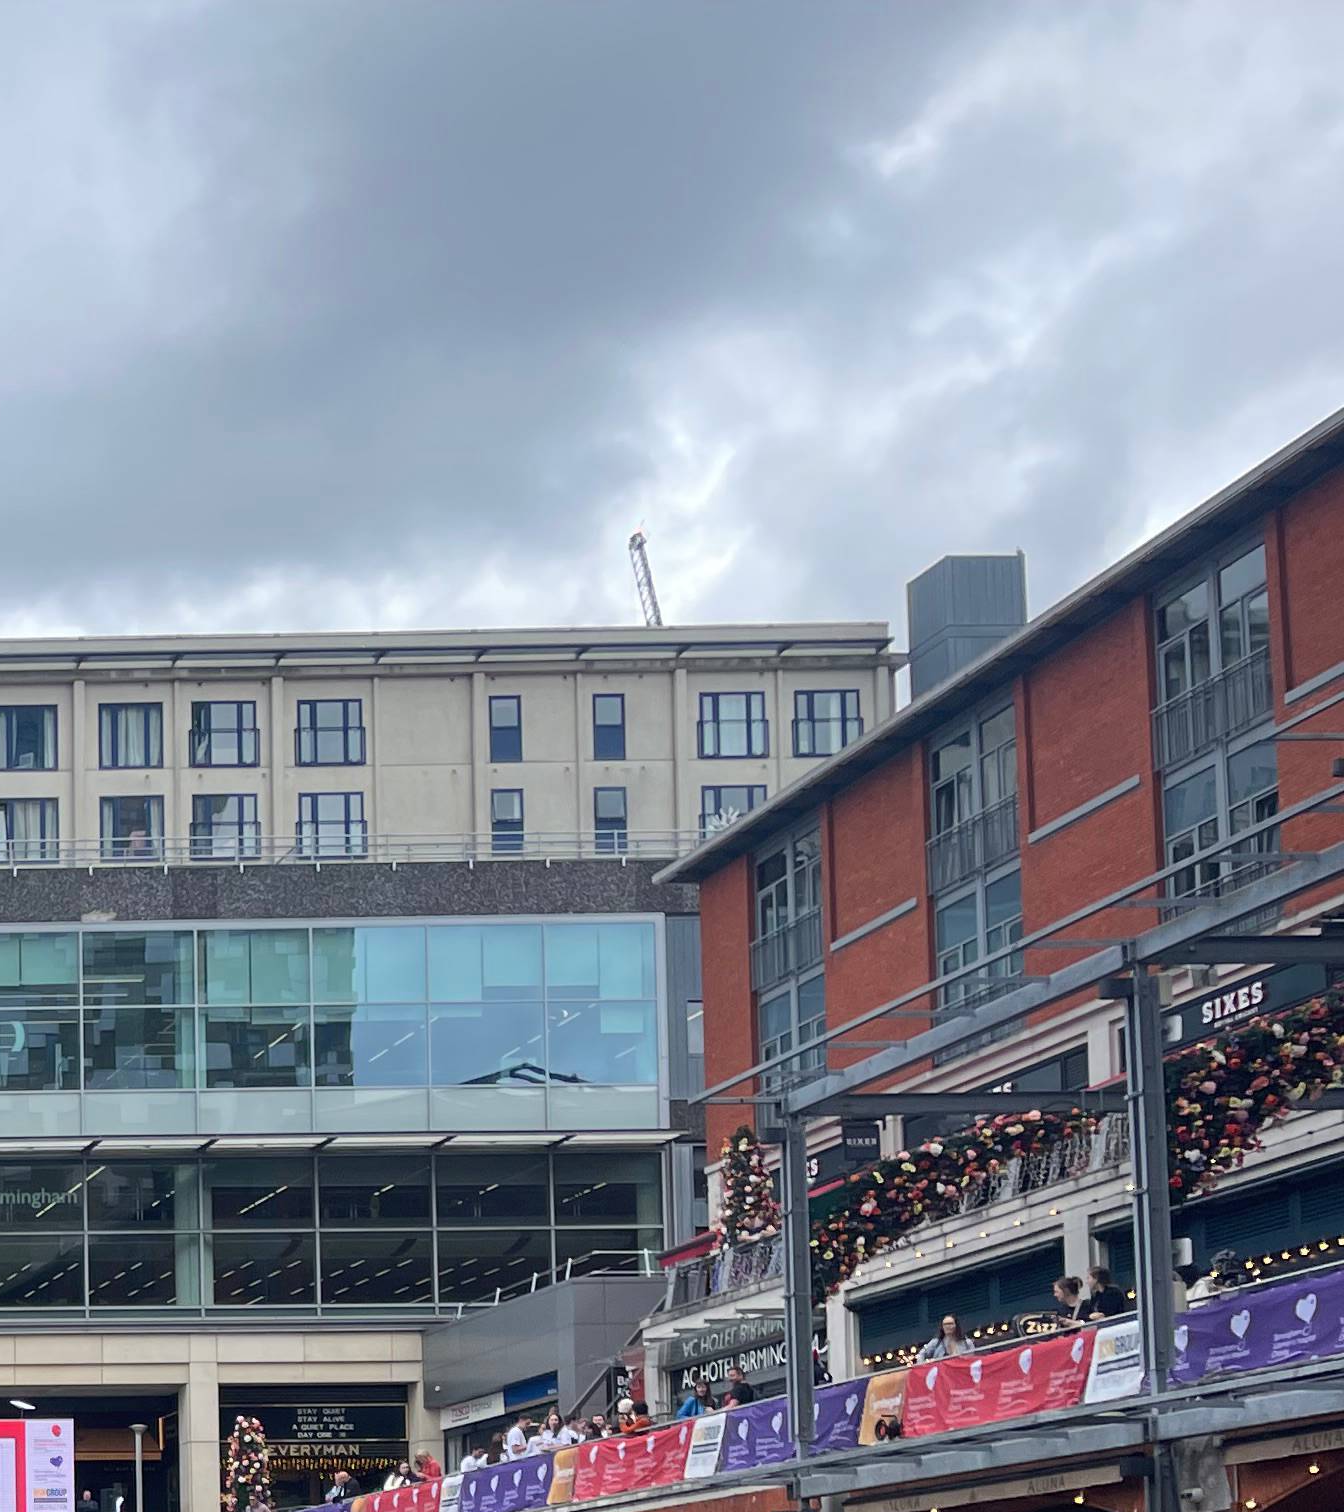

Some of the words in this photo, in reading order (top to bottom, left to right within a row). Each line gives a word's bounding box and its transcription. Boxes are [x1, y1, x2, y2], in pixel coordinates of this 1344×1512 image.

[1201, 981, 1264, 1024] SIXES
[1025, 1320, 1058, 1334] Zizz
[682, 1363, 699, 1390] AC
[267, 1444, 360, 1456] EVERYMAN
[1026, 1475, 1067, 1494] ALUNA
